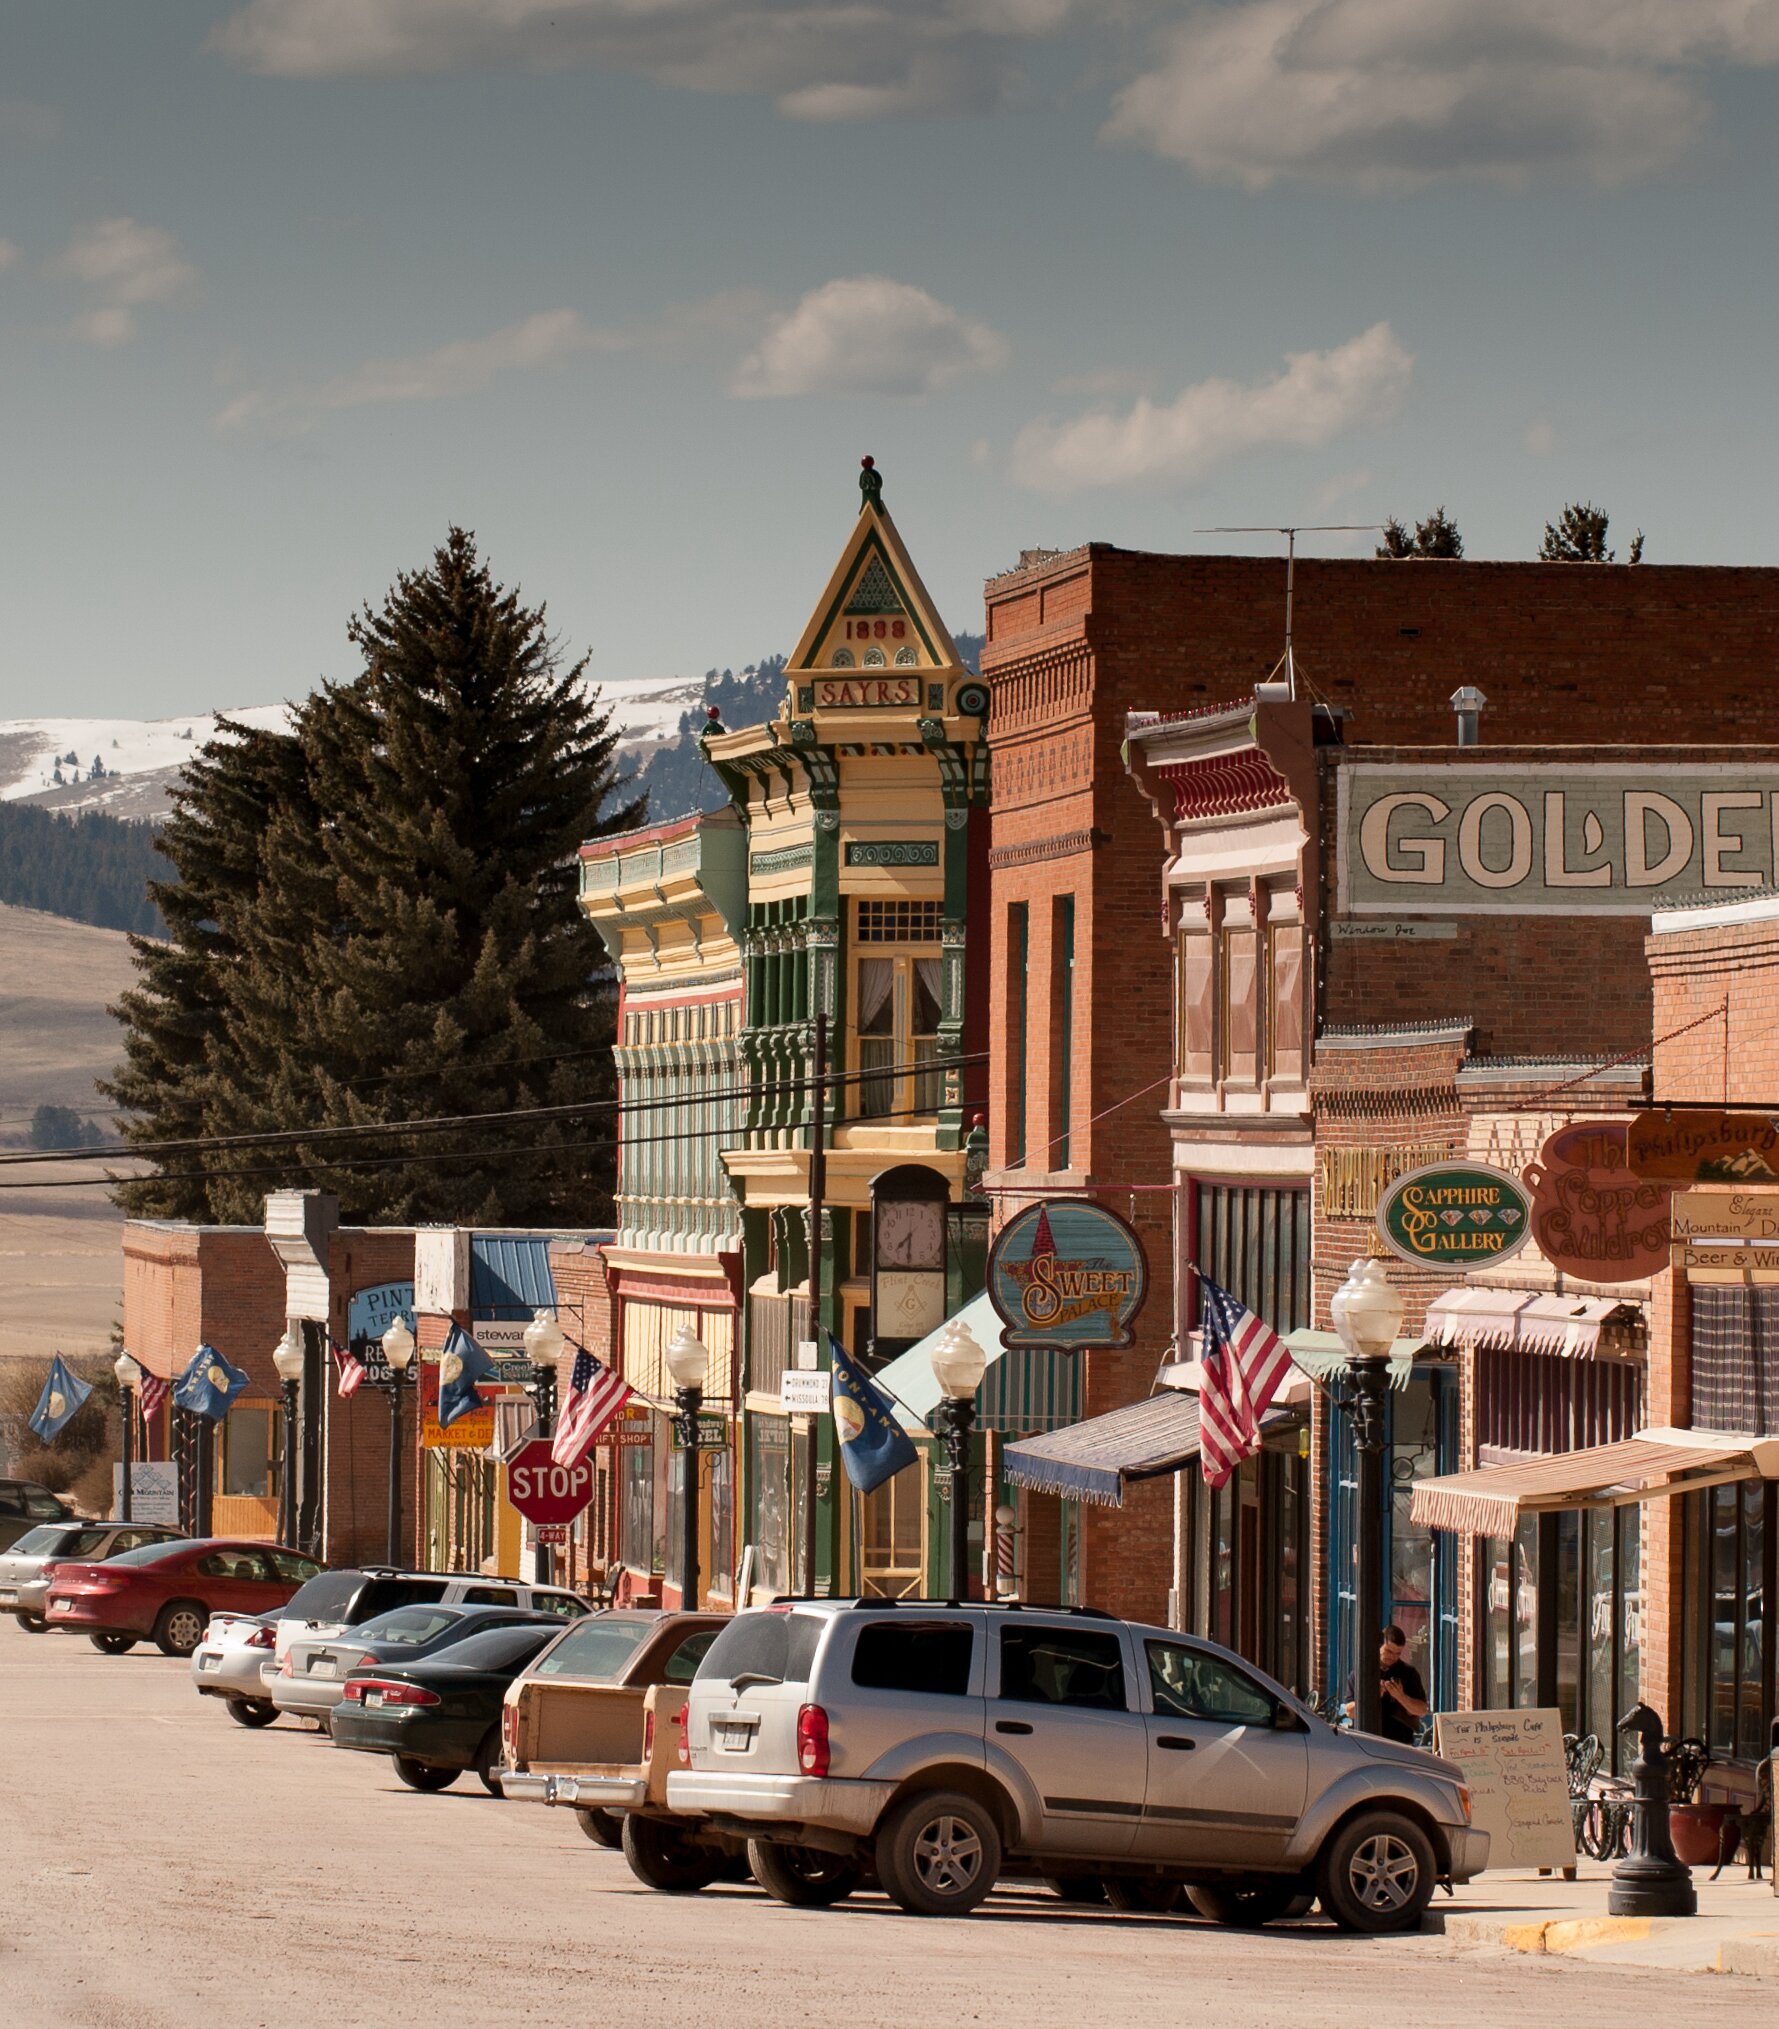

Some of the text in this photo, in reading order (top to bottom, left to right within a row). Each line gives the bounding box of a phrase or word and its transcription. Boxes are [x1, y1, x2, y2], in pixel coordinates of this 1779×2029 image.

[846, 620, 905, 640] 1888
[821, 680, 910, 703] SAYRS
[1395, 923, 1417, 936] Joe
[1577, 1133, 1628, 1173] Th
[1555, 1168, 1672, 1224] Copper
[1674, 1218, 1741, 1235] Mountain
[1684, 1249, 1729, 1266] Beer
[1733, 1251, 1748, 1266] &
[1060, 1294, 1121, 1322] PALACE
[427, 1428, 466, 1439] MARKET
[620, 1434, 647, 1444] SHOP
[513, 1466, 588, 1499] STOP
[539, 1531, 566, 1540] 4-WAY
